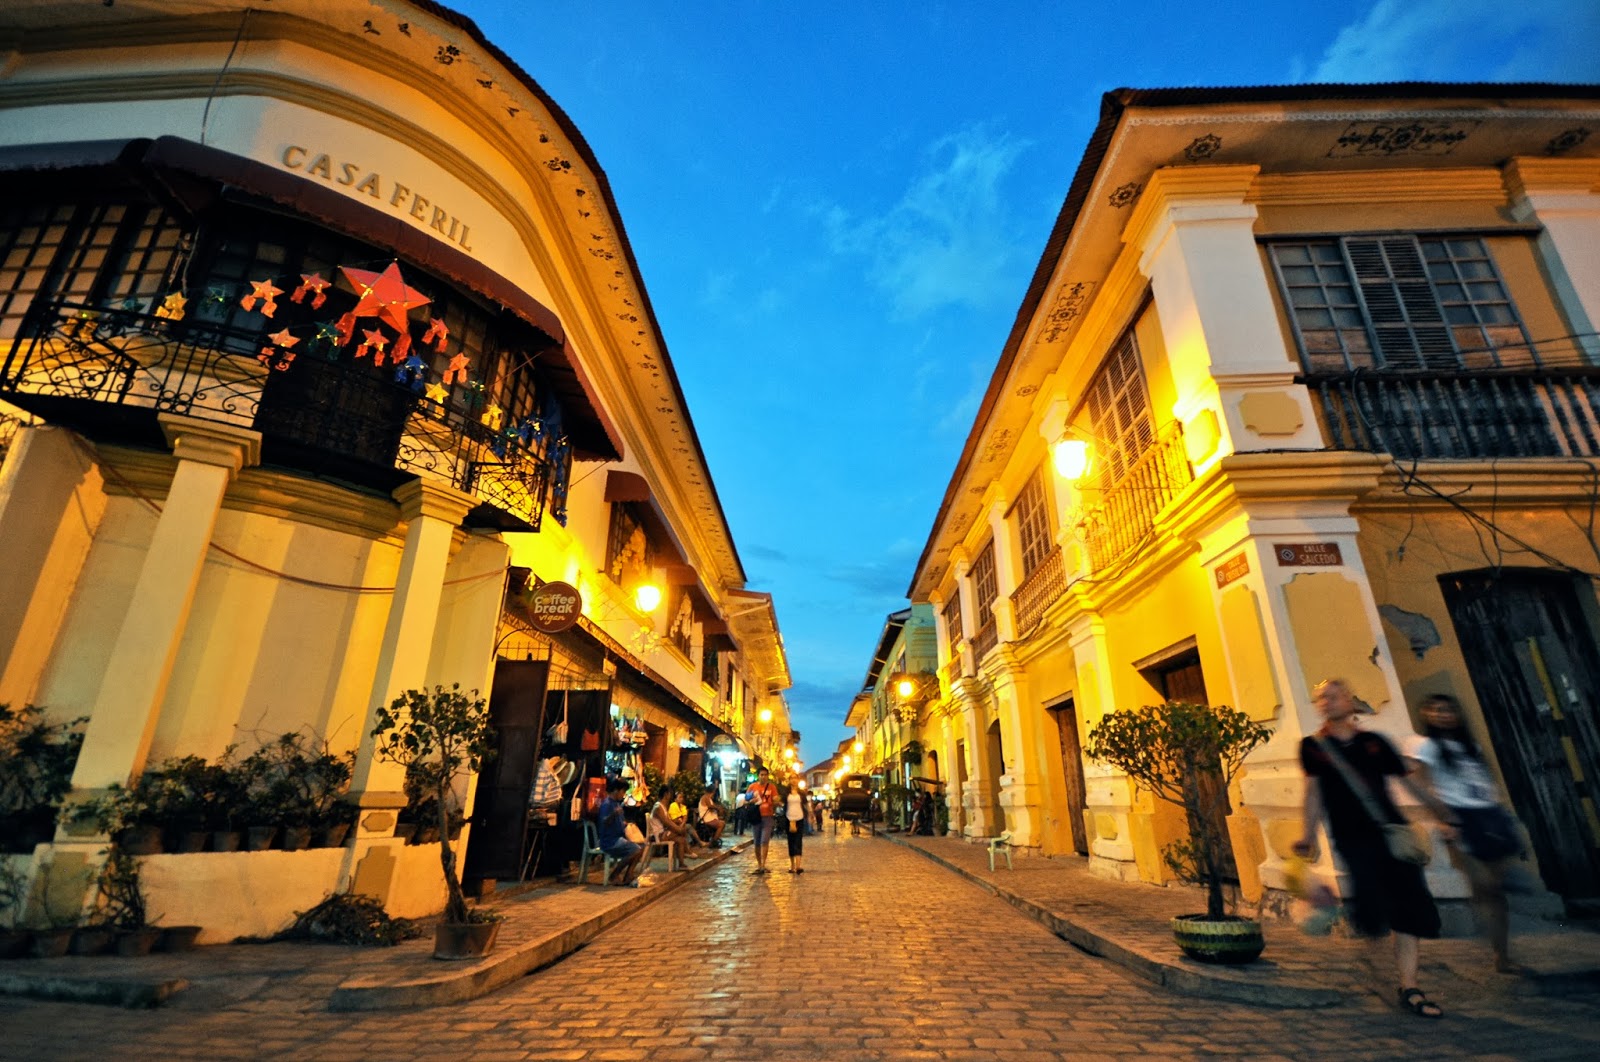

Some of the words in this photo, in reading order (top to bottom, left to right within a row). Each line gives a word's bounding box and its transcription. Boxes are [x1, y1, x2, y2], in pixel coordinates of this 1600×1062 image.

[282, 146, 380, 199] CASA
[390, 181, 472, 252] FERIL
[1300, 554, 1337, 564] SALCEDO
[534, 604, 574, 614] break
[539, 612, 566, 625] vigan
